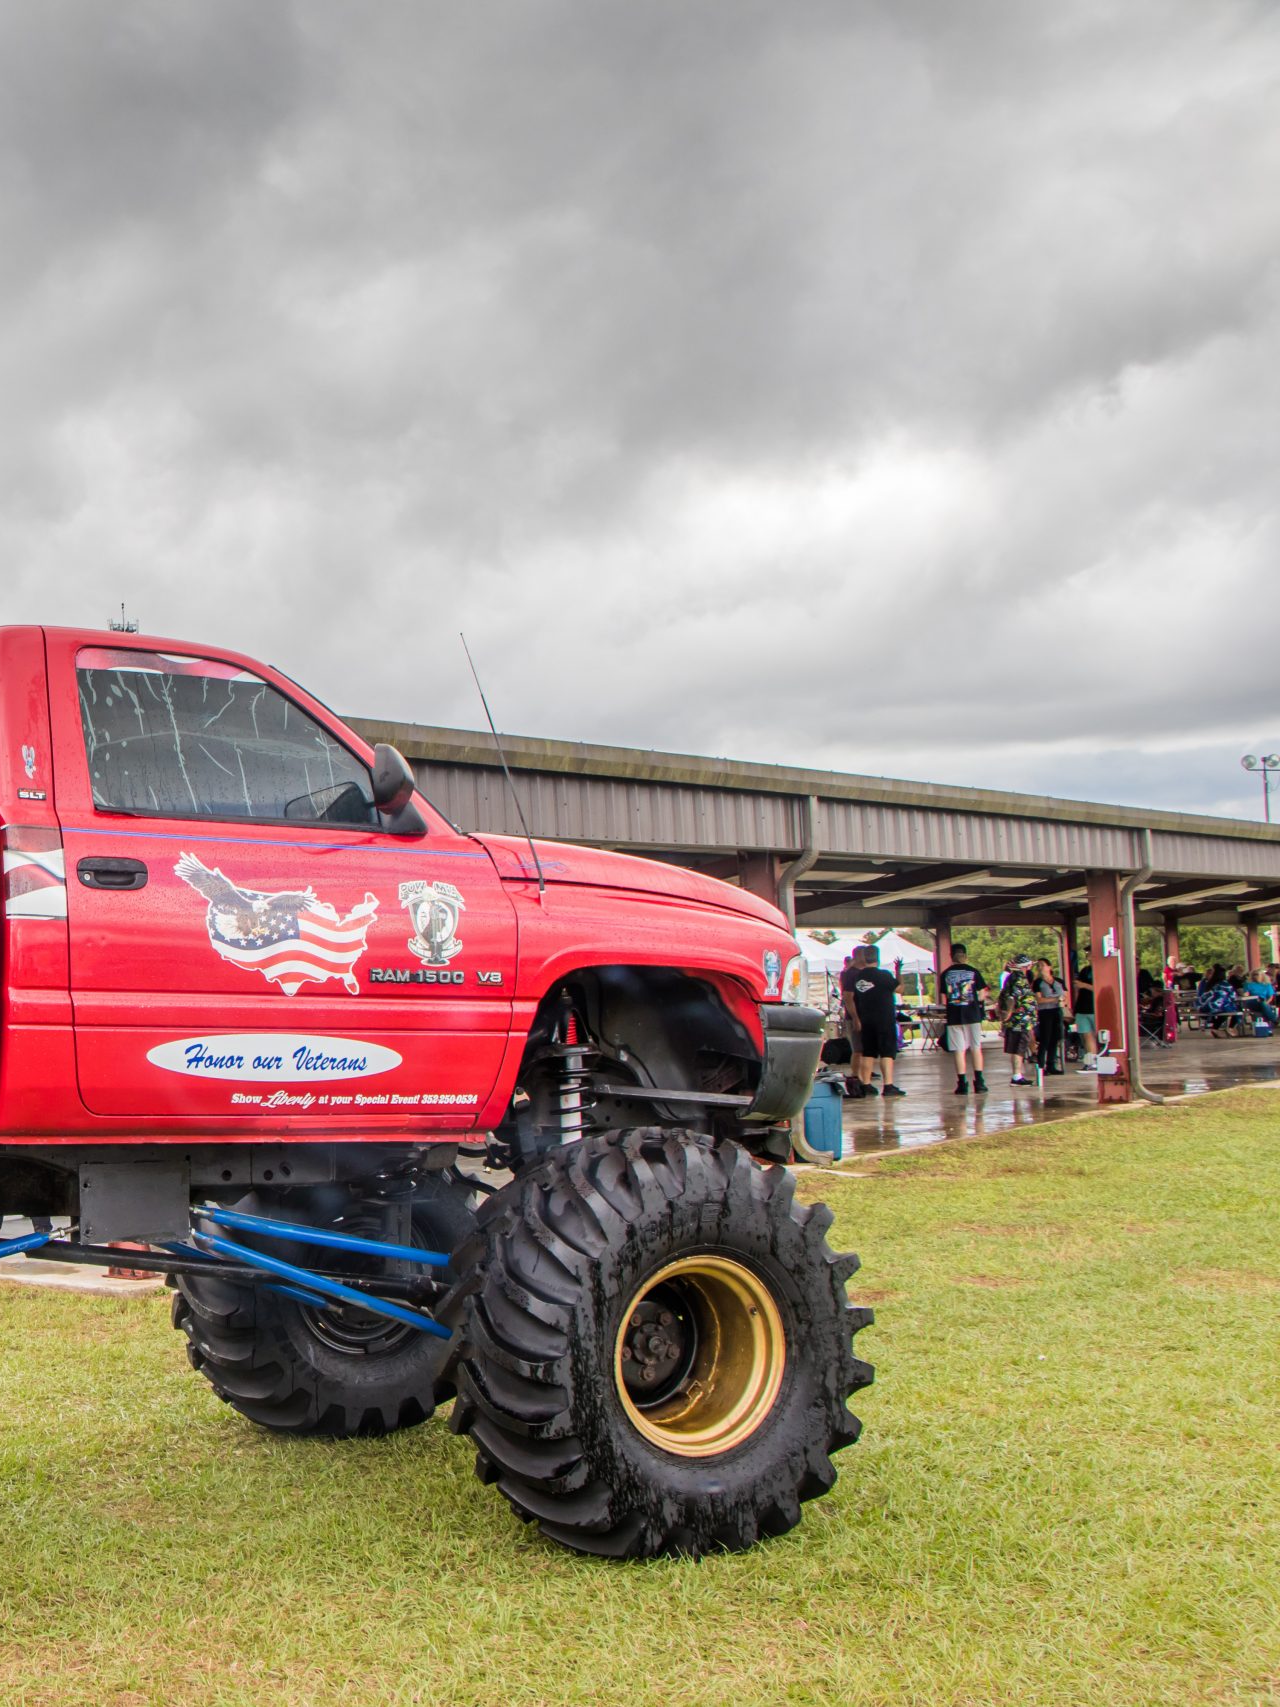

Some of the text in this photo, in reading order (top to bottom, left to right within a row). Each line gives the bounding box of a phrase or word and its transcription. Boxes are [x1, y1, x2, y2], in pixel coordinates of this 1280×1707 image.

[19, 791, 45, 799] SLT
[370, 968, 465, 984] RAM 1500
[477, 971, 503, 983] V8
[184, 1043, 368, 1072] Honor our Veterans
[231, 1093, 262, 1104] Show
[260, 1090, 316, 1109] Liberty
[318, 1095, 329, 1105] at
[330, 1096, 353, 1106] your
[354, 1094, 390, 1106] Special
[391, 1094, 420, 1105] Event!
